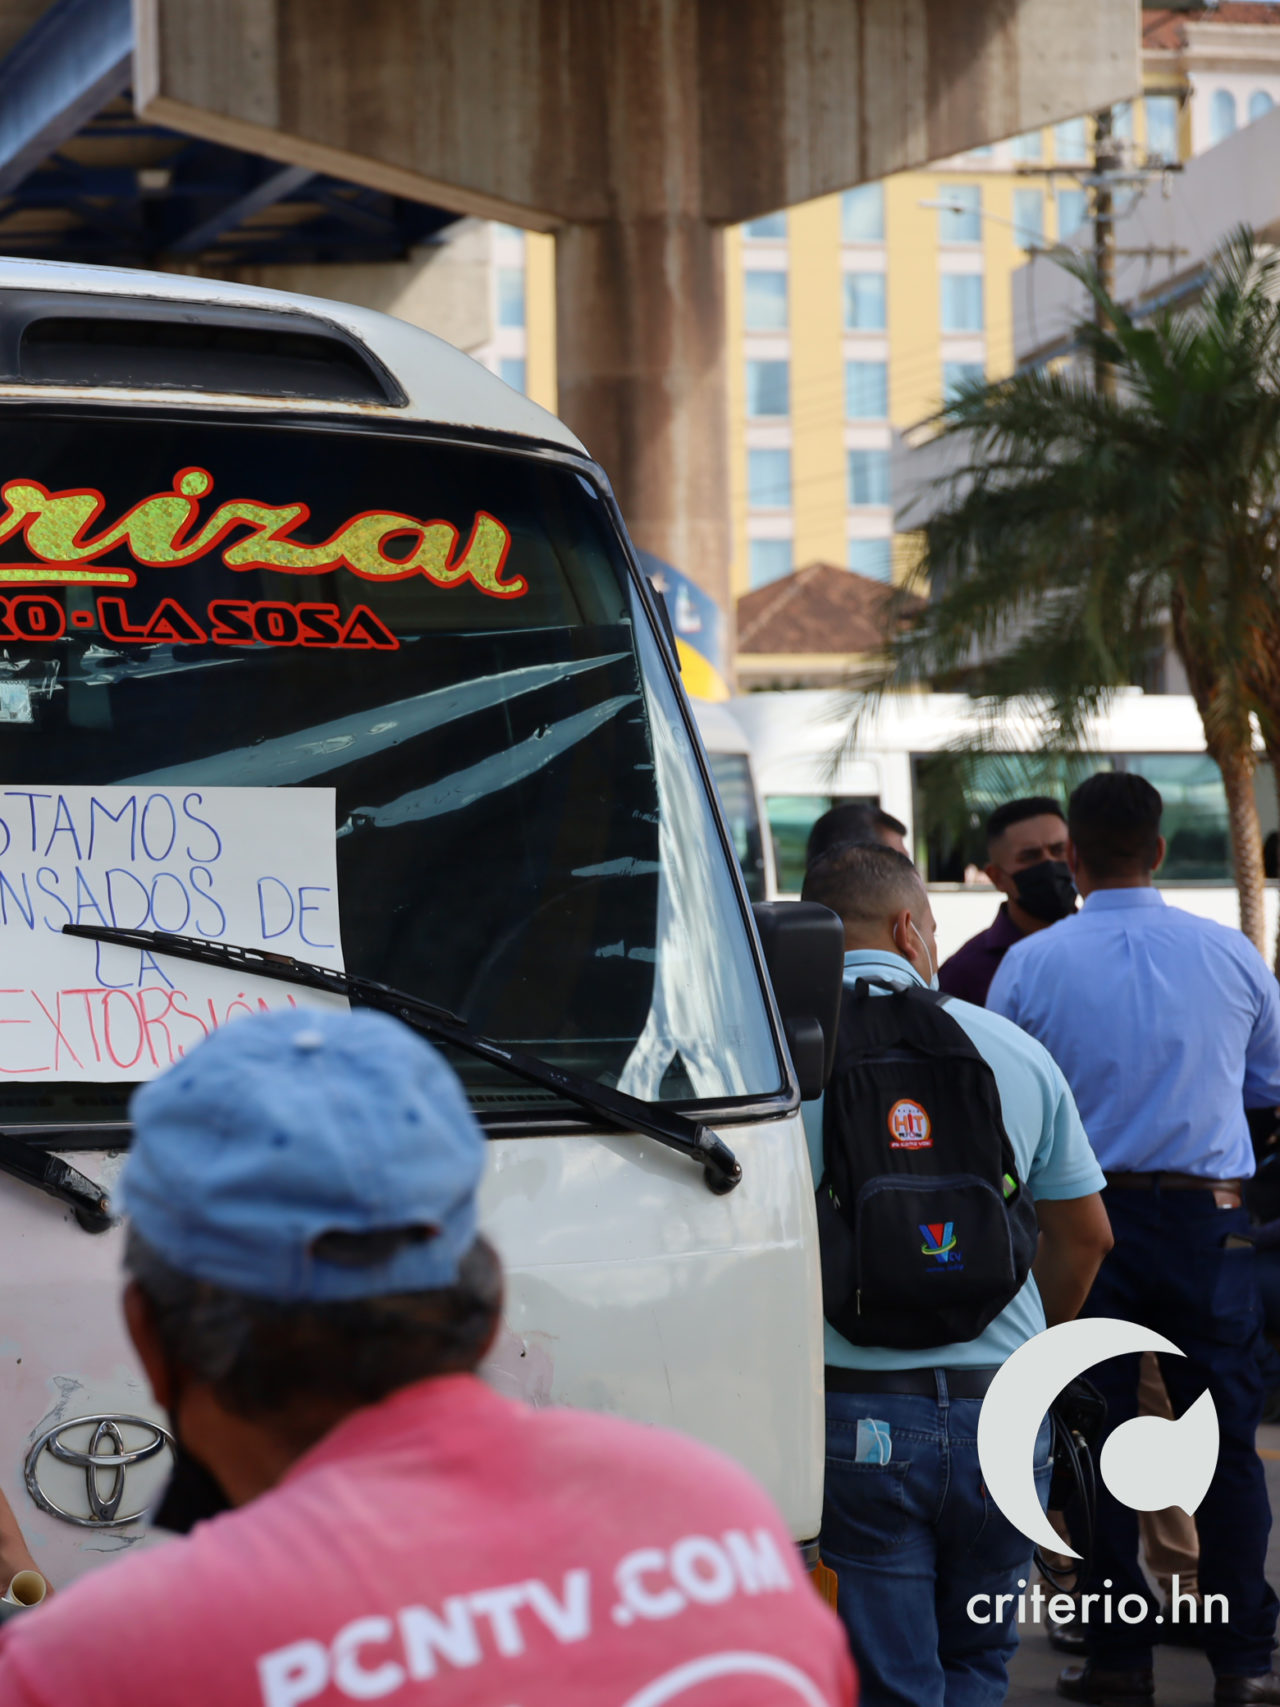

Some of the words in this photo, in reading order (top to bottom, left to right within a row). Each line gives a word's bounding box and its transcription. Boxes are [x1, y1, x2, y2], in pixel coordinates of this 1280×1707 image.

[208, 600, 400, 650] SOSA
[257, 876, 335, 948] DE
[95, 939, 175, 989] LA
